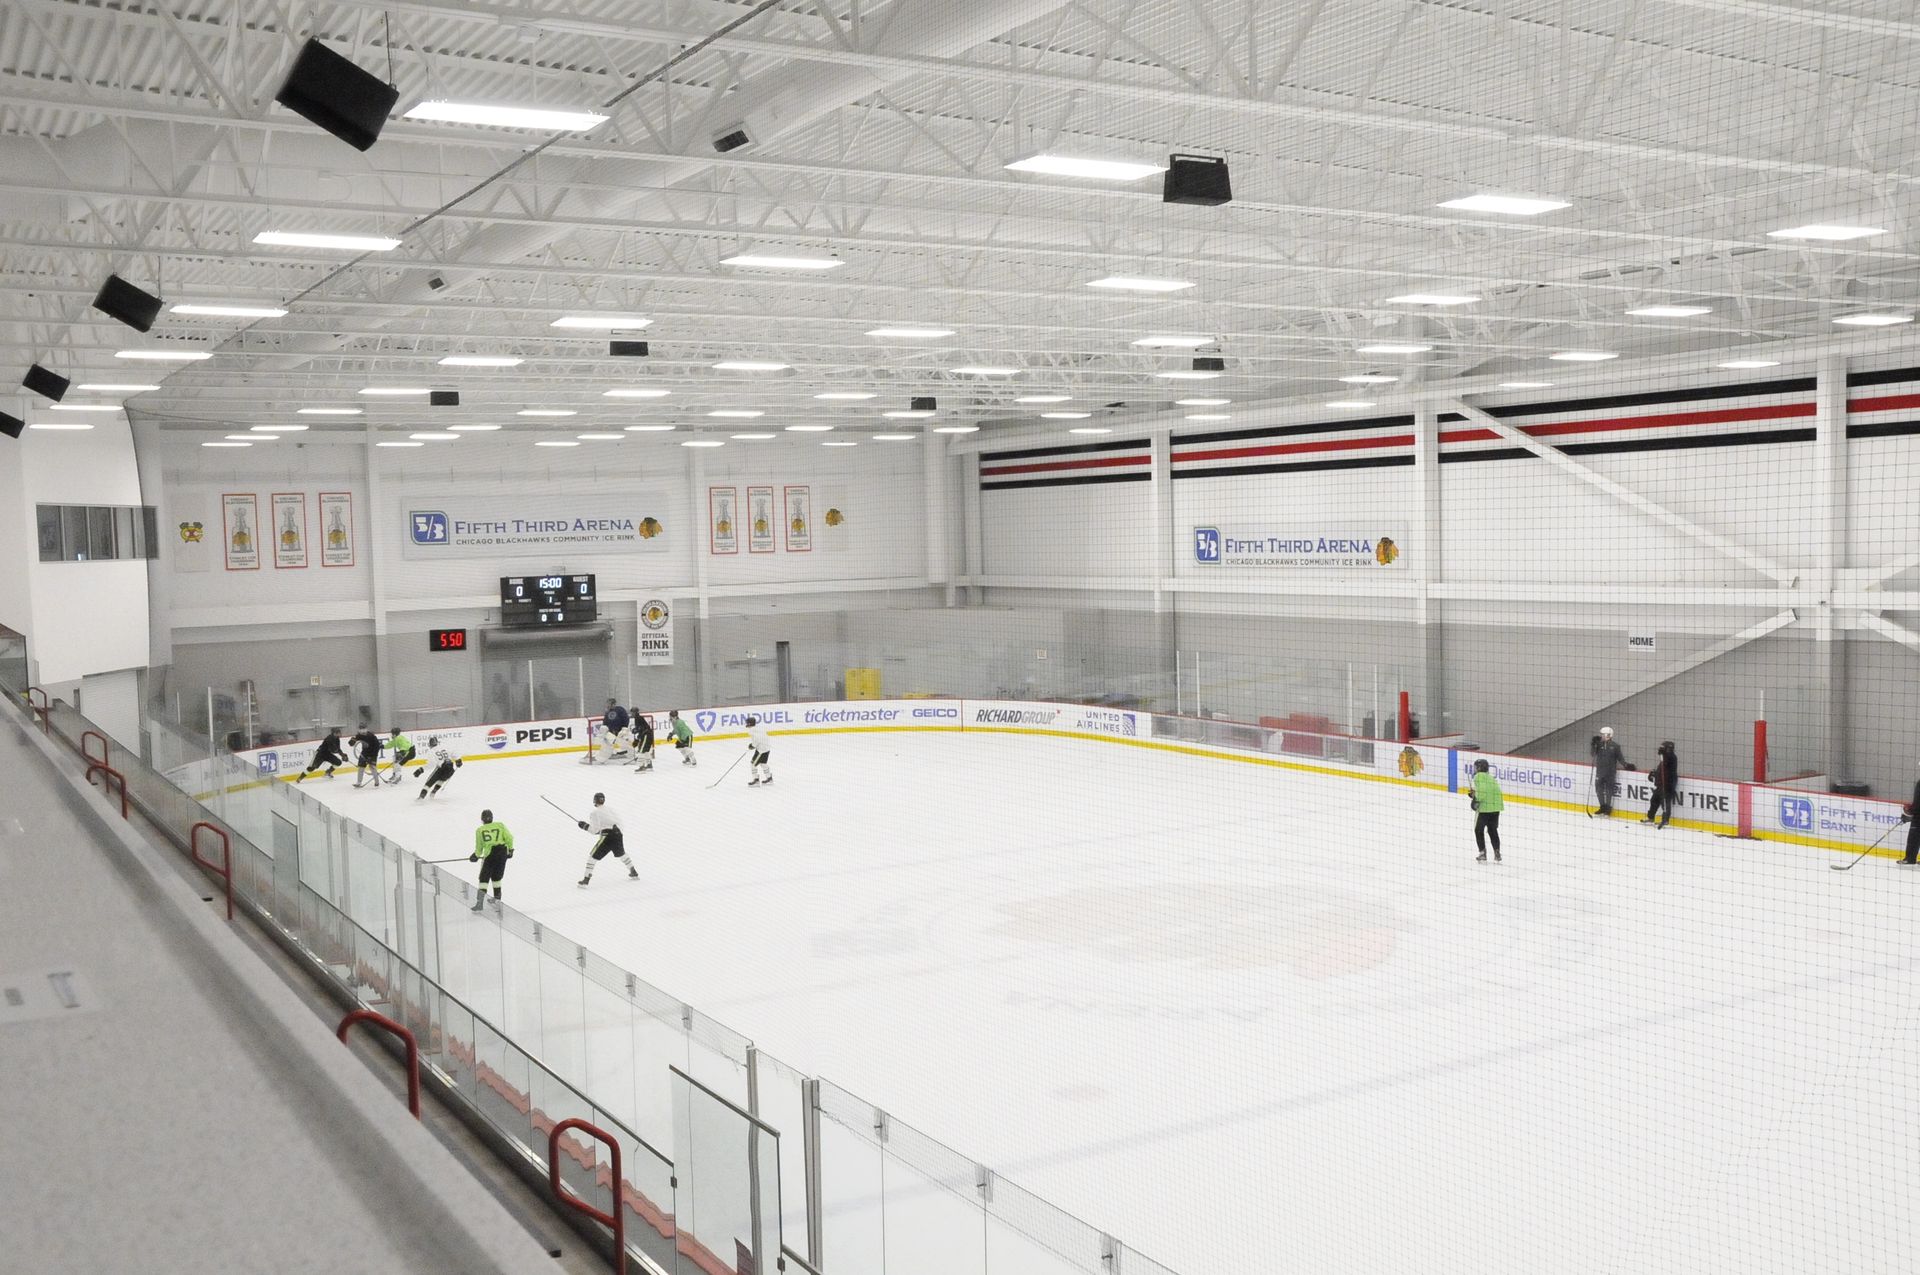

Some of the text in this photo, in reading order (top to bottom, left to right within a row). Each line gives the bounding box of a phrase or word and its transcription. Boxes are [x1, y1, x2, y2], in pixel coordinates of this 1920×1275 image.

[455, 518, 634, 534] FIFTH THIRD ARENA
[553, 535, 599, 543] COMMUNITY
[1226, 538, 1371, 553] FIFTH THIRD ARENA
[539, 577, 562, 589] 15:00
[580, 583, 587, 594] 0
[516, 586, 523, 597] 0
[541, 613, 547, 622] 0
[558, 613, 563, 621] 0
[642, 640, 669, 650] RINK
[1629, 636, 1654, 646] HOME
[721, 710, 793, 727] FANDUEL
[804, 708, 900, 723] ticketmaster
[912, 708, 958, 718] GEICO
[1086, 711, 1120, 721] UNITED
[1077, 720, 1120, 733] AIRLINES
[515, 727, 572, 743] PEPSI
[282, 751, 304, 760] FIFTH
[282, 761, 304, 769] BANK
[1627, 784, 1729, 812] NEN TIRE
[1821, 806, 1856, 820] FIFTH
[1821, 820, 1856, 833] BANK
[481, 828, 500, 842] 67
